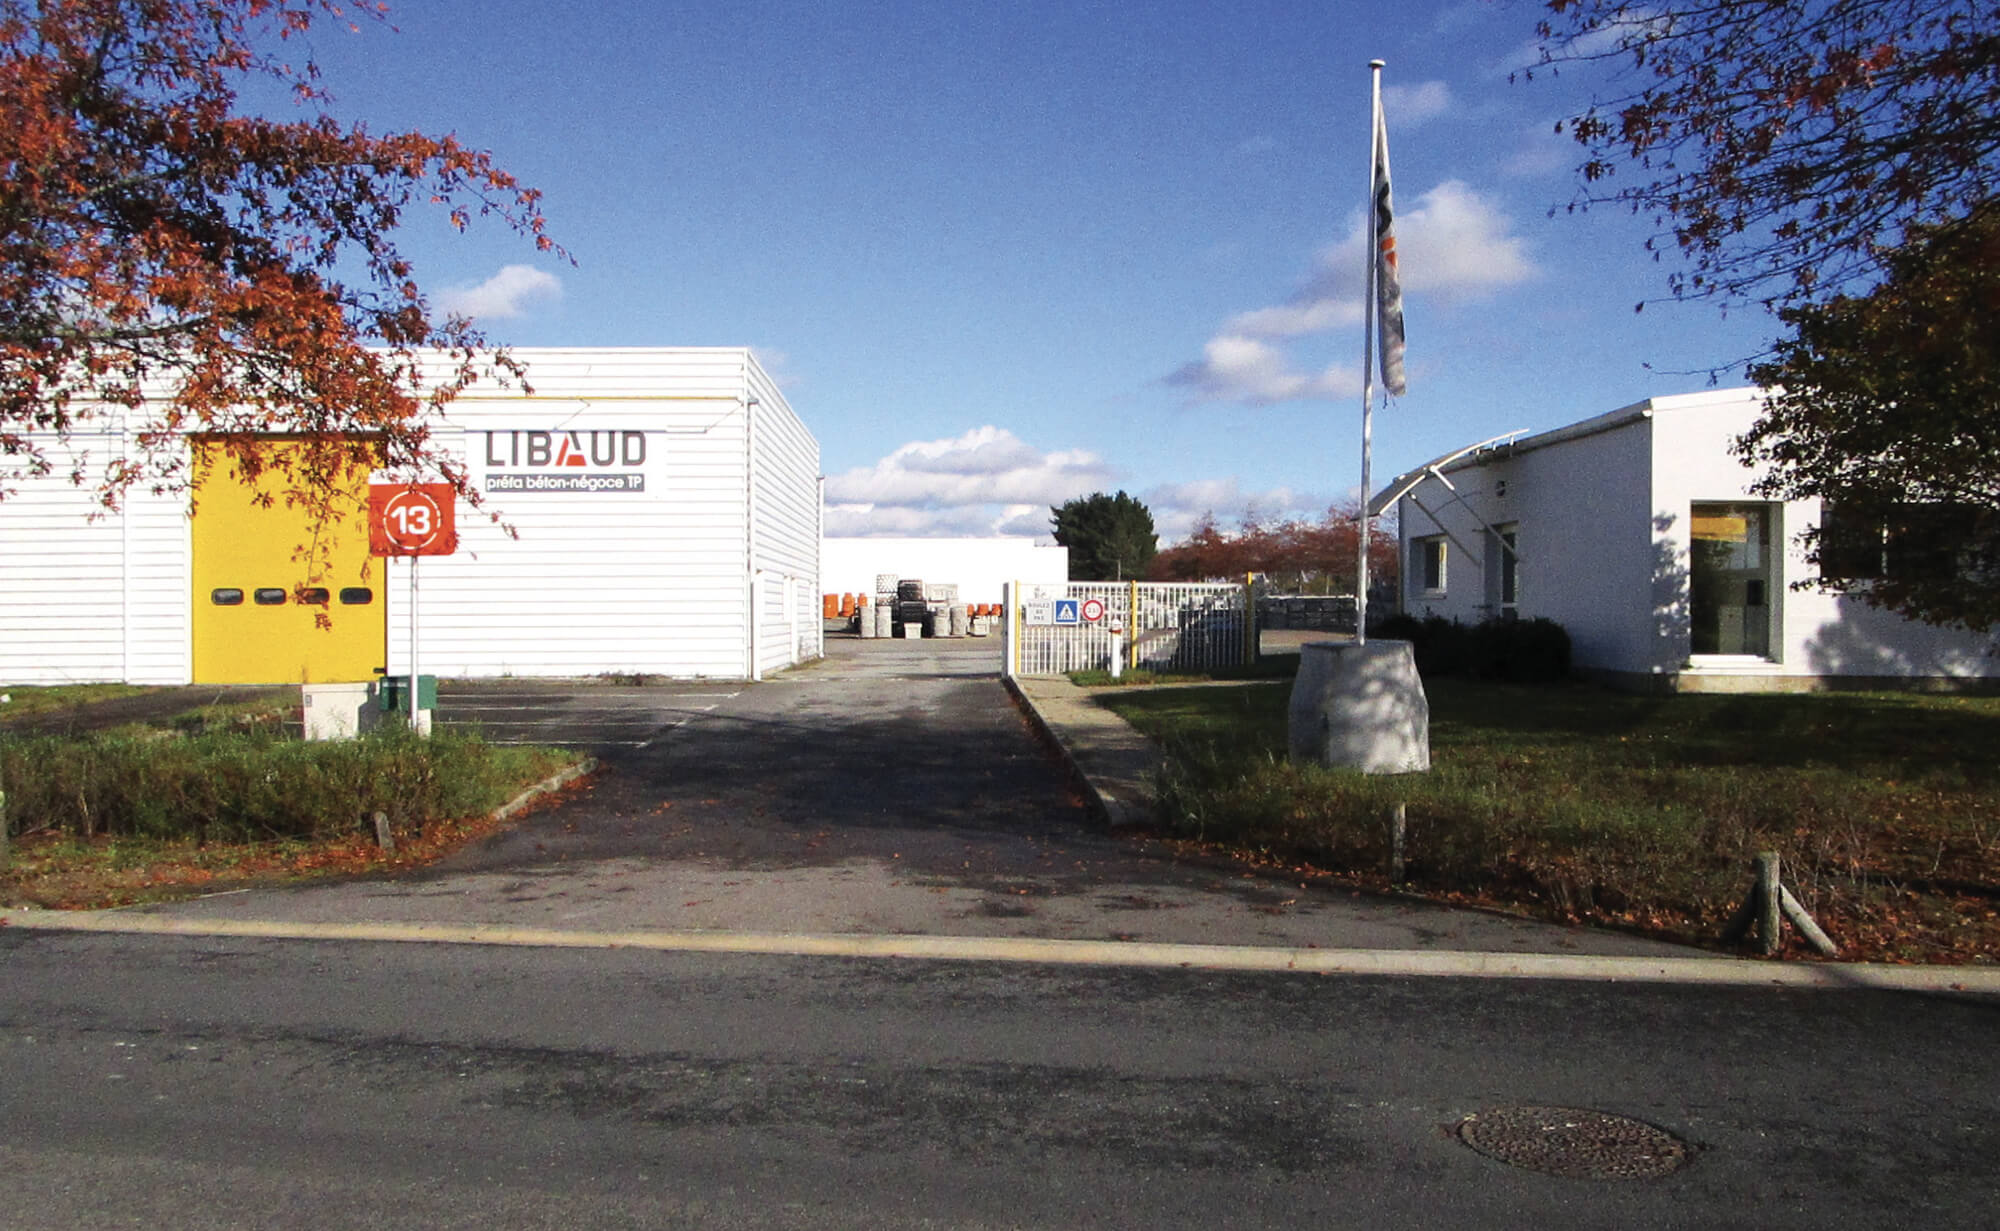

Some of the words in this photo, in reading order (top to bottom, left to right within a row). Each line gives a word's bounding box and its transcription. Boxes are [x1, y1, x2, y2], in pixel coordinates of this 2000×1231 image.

[486, 431, 646, 466] LIBAUD
[486, 475, 523, 491] préfa
[627, 475, 642, 489] TP
[390, 505, 431, 535] 13
